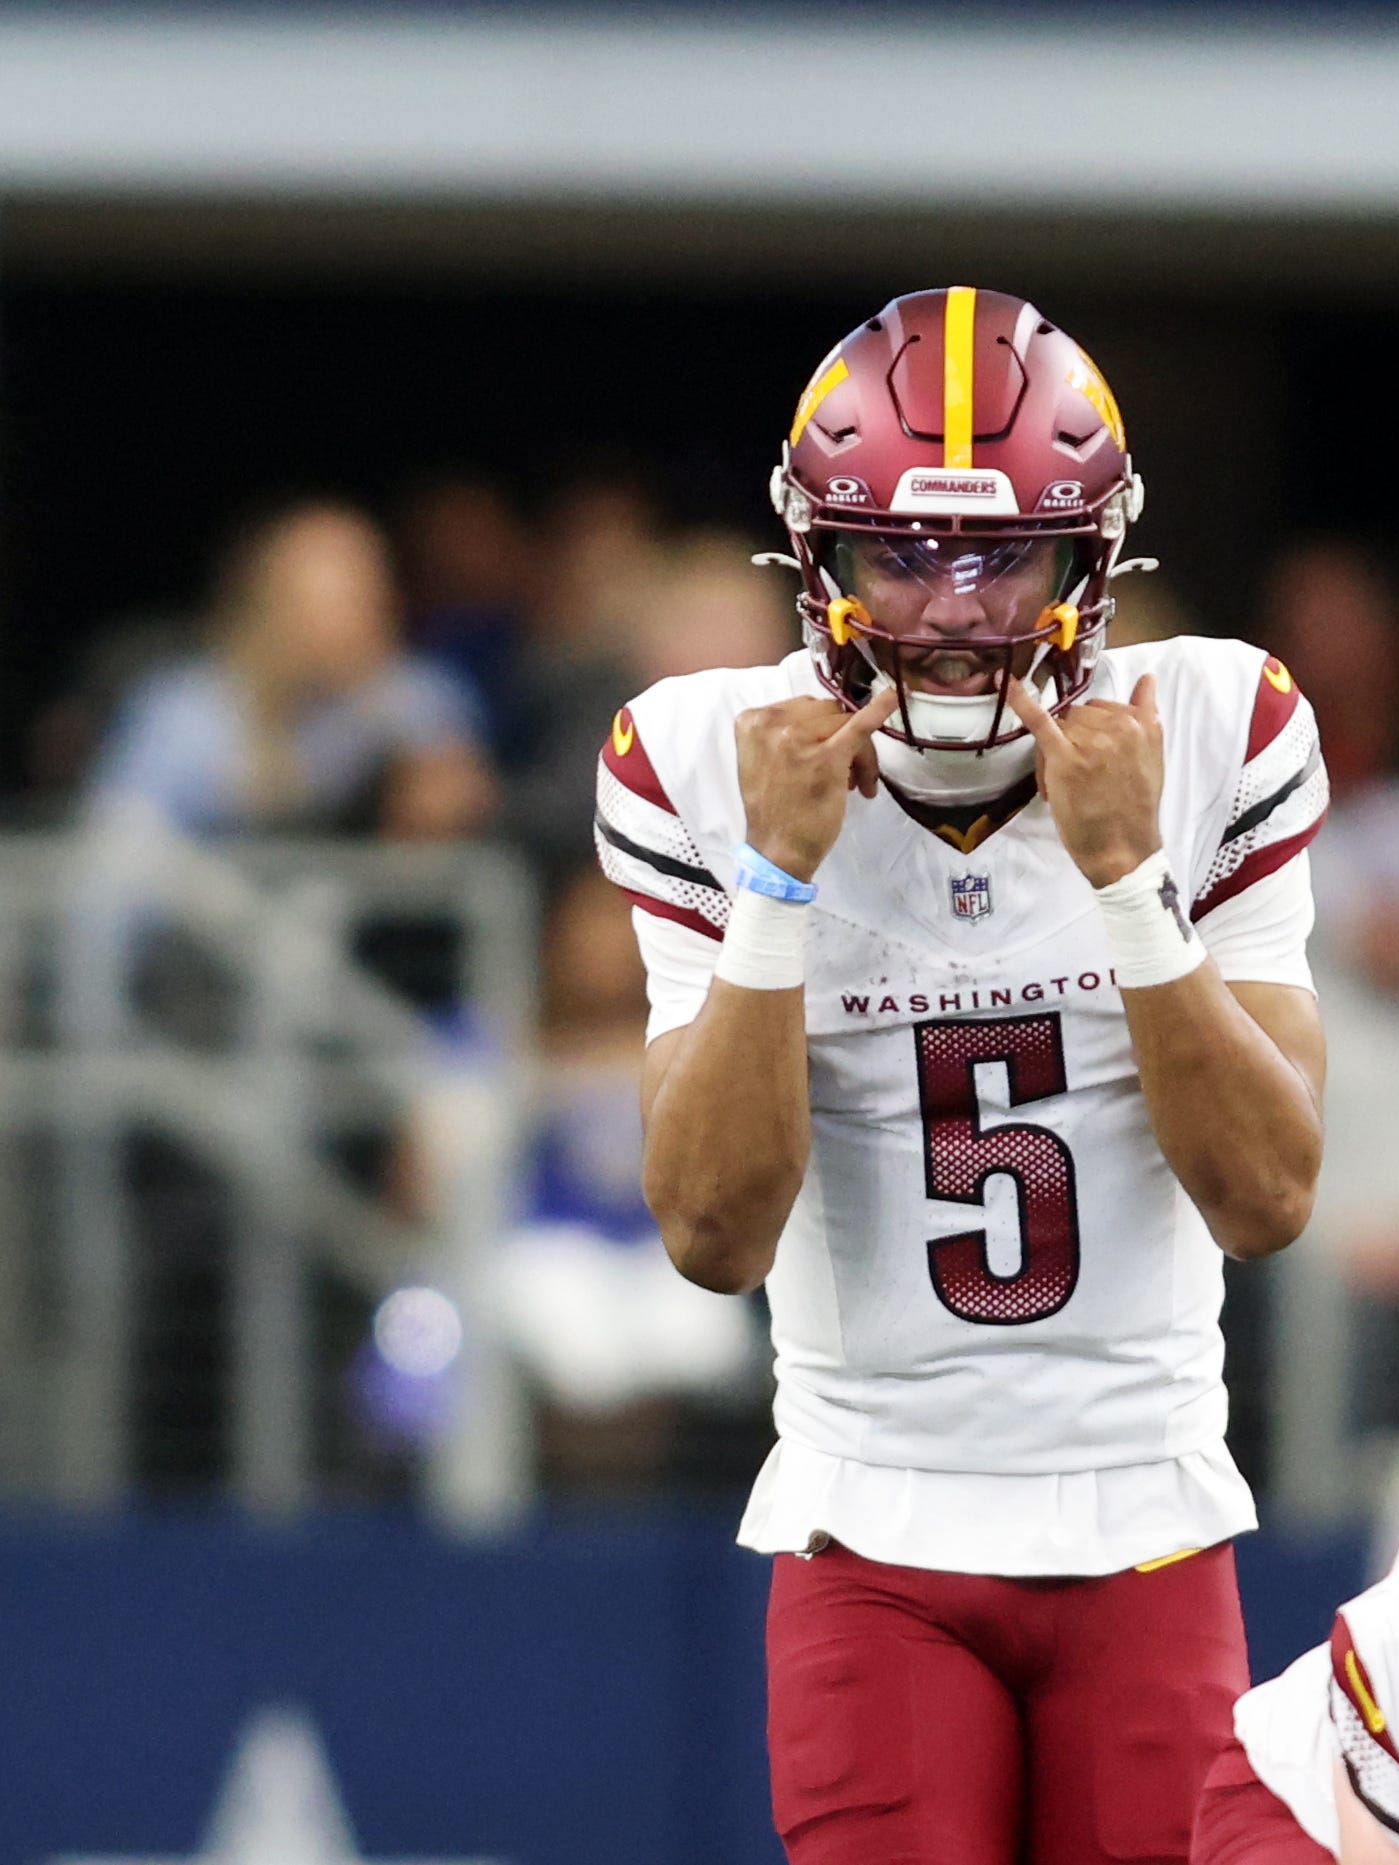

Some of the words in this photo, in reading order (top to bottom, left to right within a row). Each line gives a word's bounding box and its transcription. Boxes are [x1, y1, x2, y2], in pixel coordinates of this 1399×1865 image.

[911, 478, 997, 494] COMMANDERS
[956, 893, 987, 915] NFL
[913, 1011, 1081, 1326] 5
